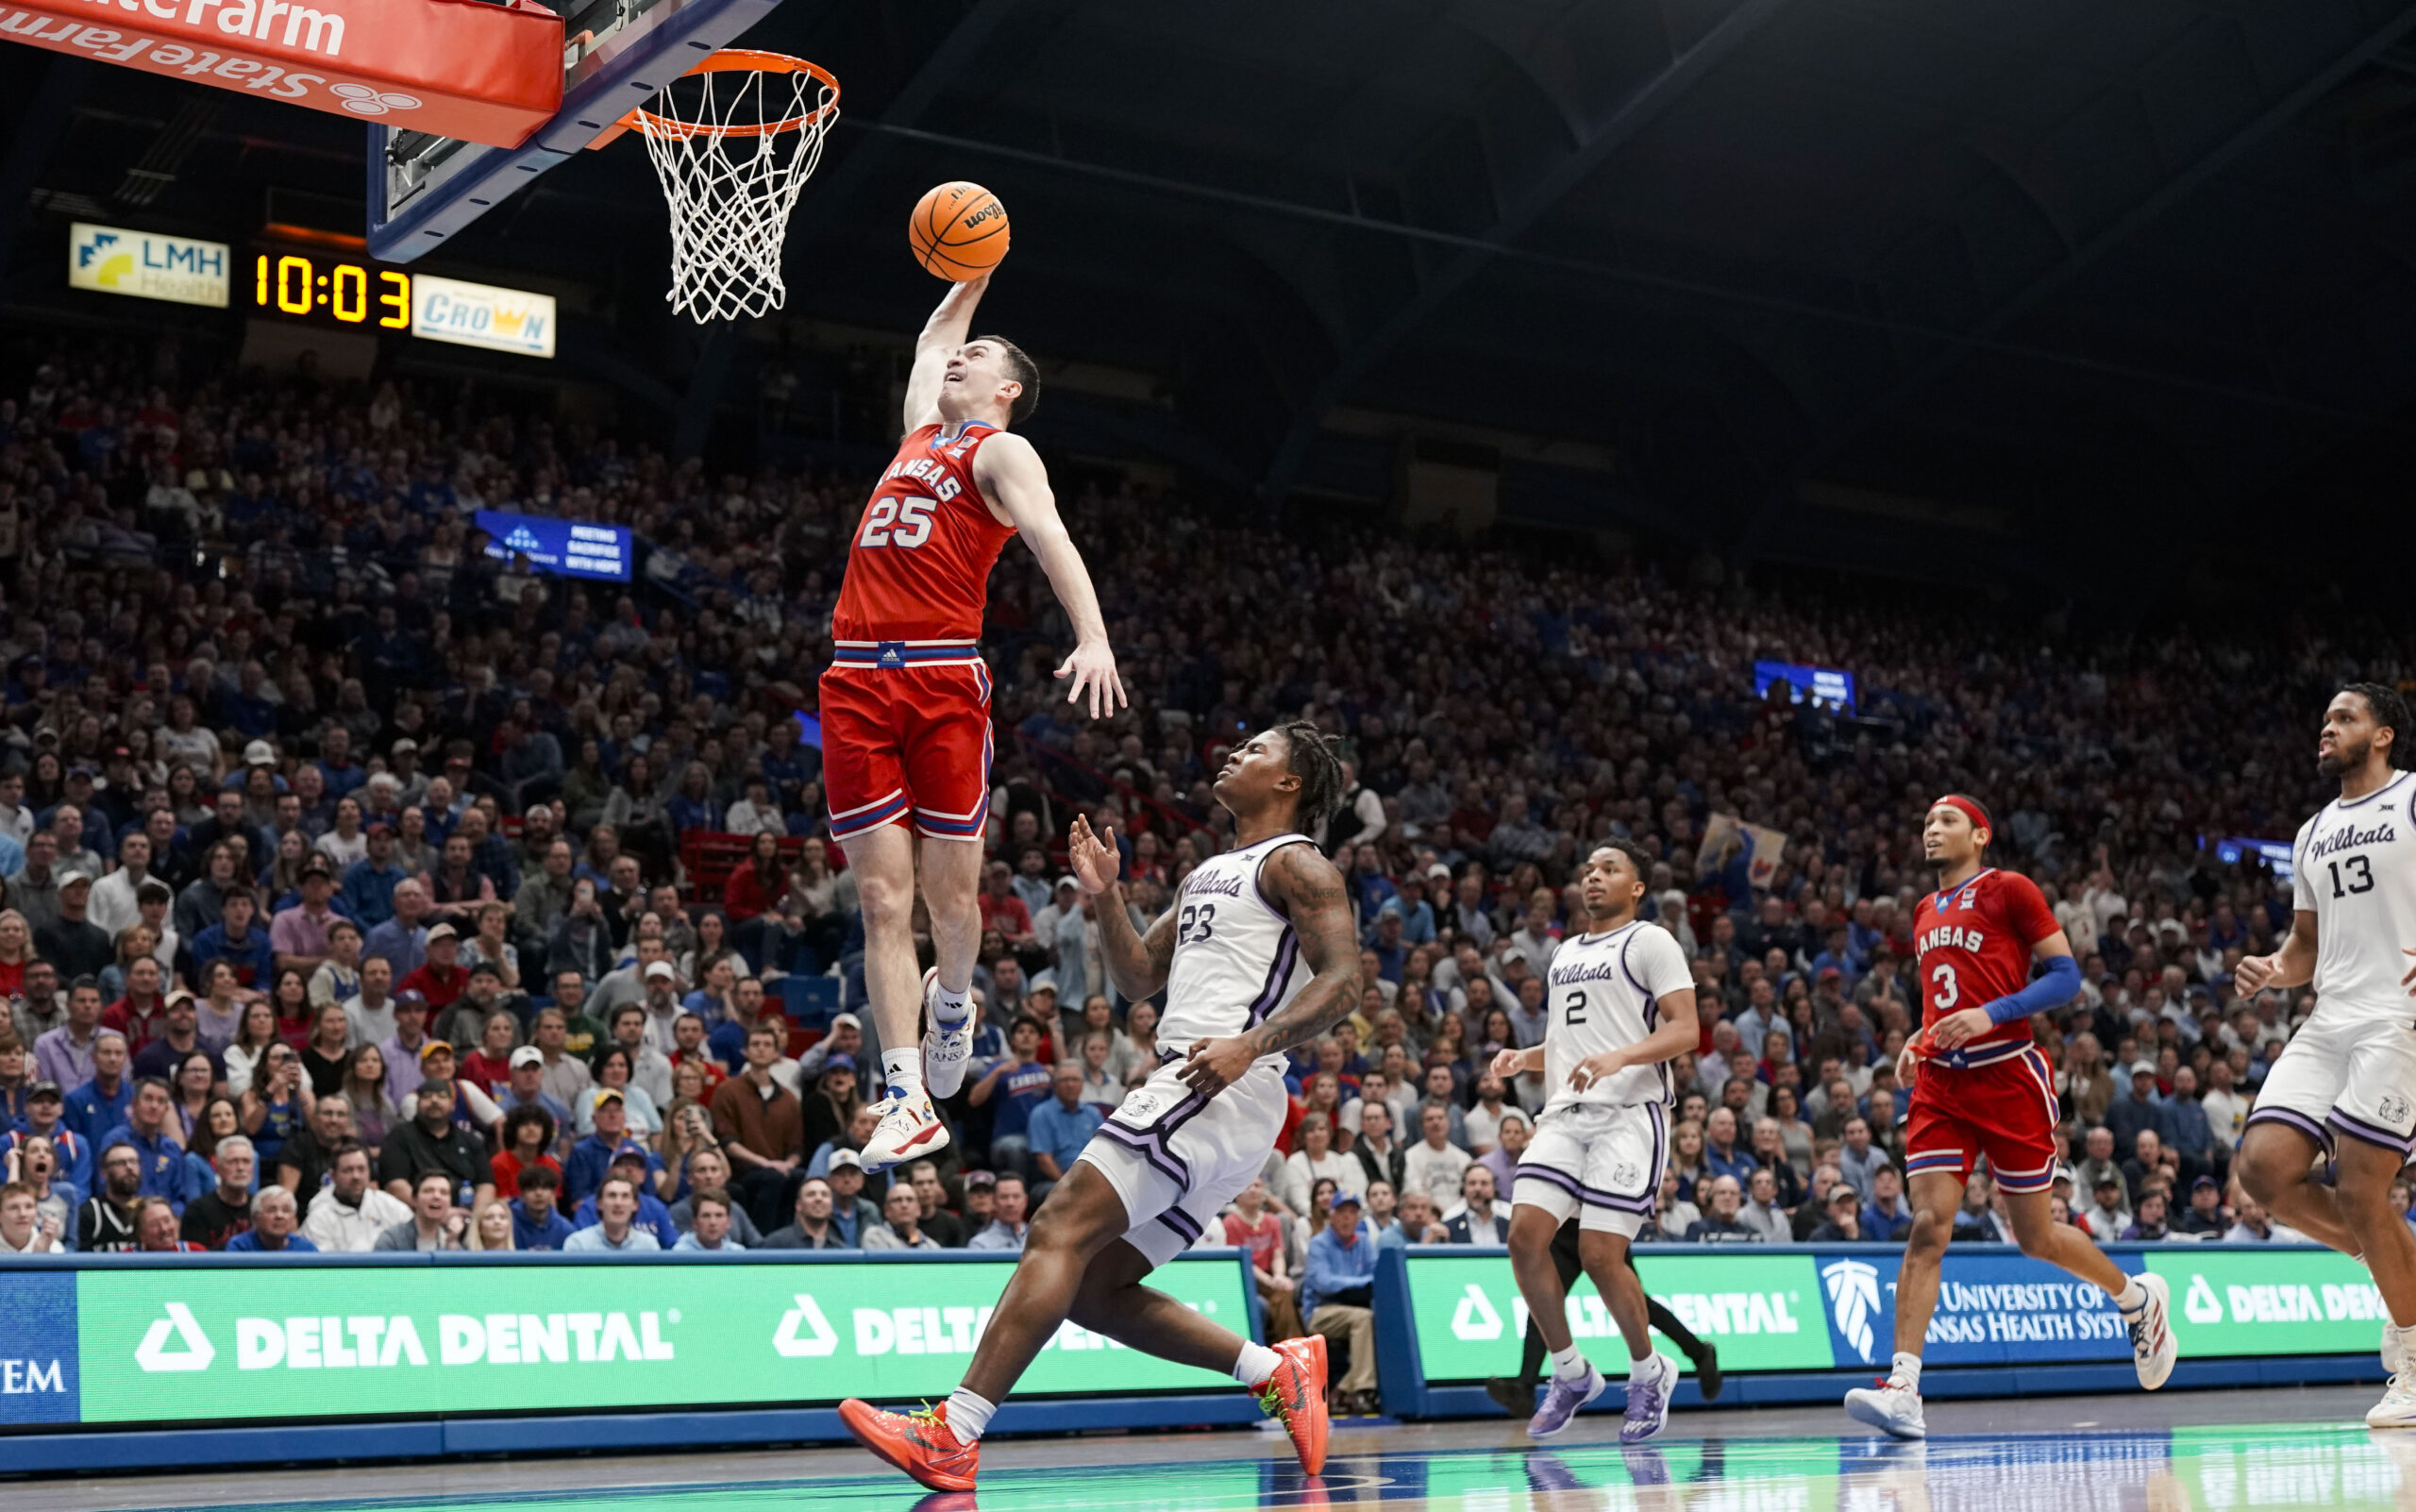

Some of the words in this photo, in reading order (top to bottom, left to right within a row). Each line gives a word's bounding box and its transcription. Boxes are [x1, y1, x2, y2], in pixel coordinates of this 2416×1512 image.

[144, 239, 221, 277] LMH
[256, 254, 411, 329] 10:03
[859, 496, 939, 548] 25
[2312, 821, 2397, 863] Wildcats
[2327, 854, 2374, 899] 13
[1179, 903, 1216, 947] 23
[1551, 962, 1613, 988] Wildcats
[1932, 963, 1958, 1010] 3
[1566, 990, 1586, 1026] 2
[1939, 1282, 2073, 1311] UNIVERSITY
[2225, 1284, 2324, 1322] DELTA
[236, 1313, 428, 1369] DELTA
[439, 1311, 674, 1366] DENTAL
[1986, 1311, 2074, 1342] HEALTH
[0, 1357, 68, 1393] EM
